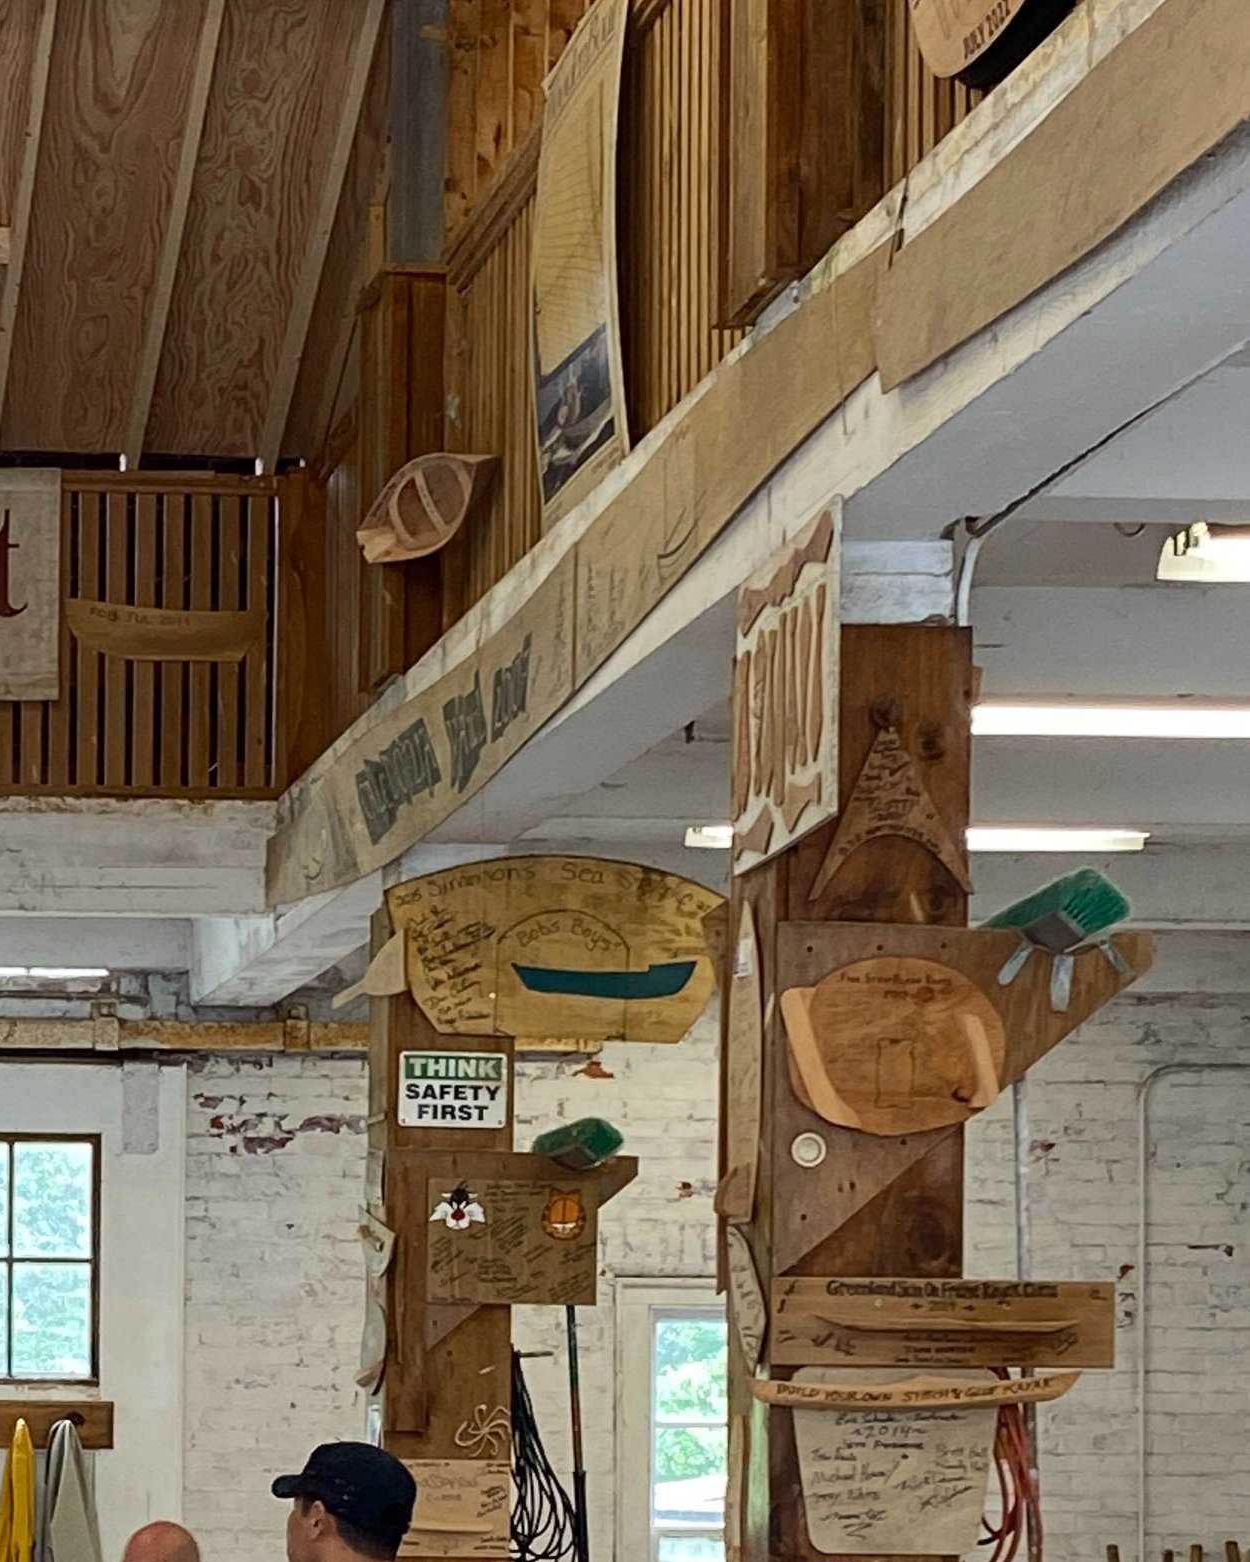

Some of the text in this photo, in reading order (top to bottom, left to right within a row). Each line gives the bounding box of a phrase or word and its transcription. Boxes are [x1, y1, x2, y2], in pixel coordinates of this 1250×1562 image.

[561, 863, 605, 884] Sea
[408, 1057, 499, 1078] THINK
[405, 1083, 501, 1101] SAFETY
[417, 1103, 489, 1121] FIRST
